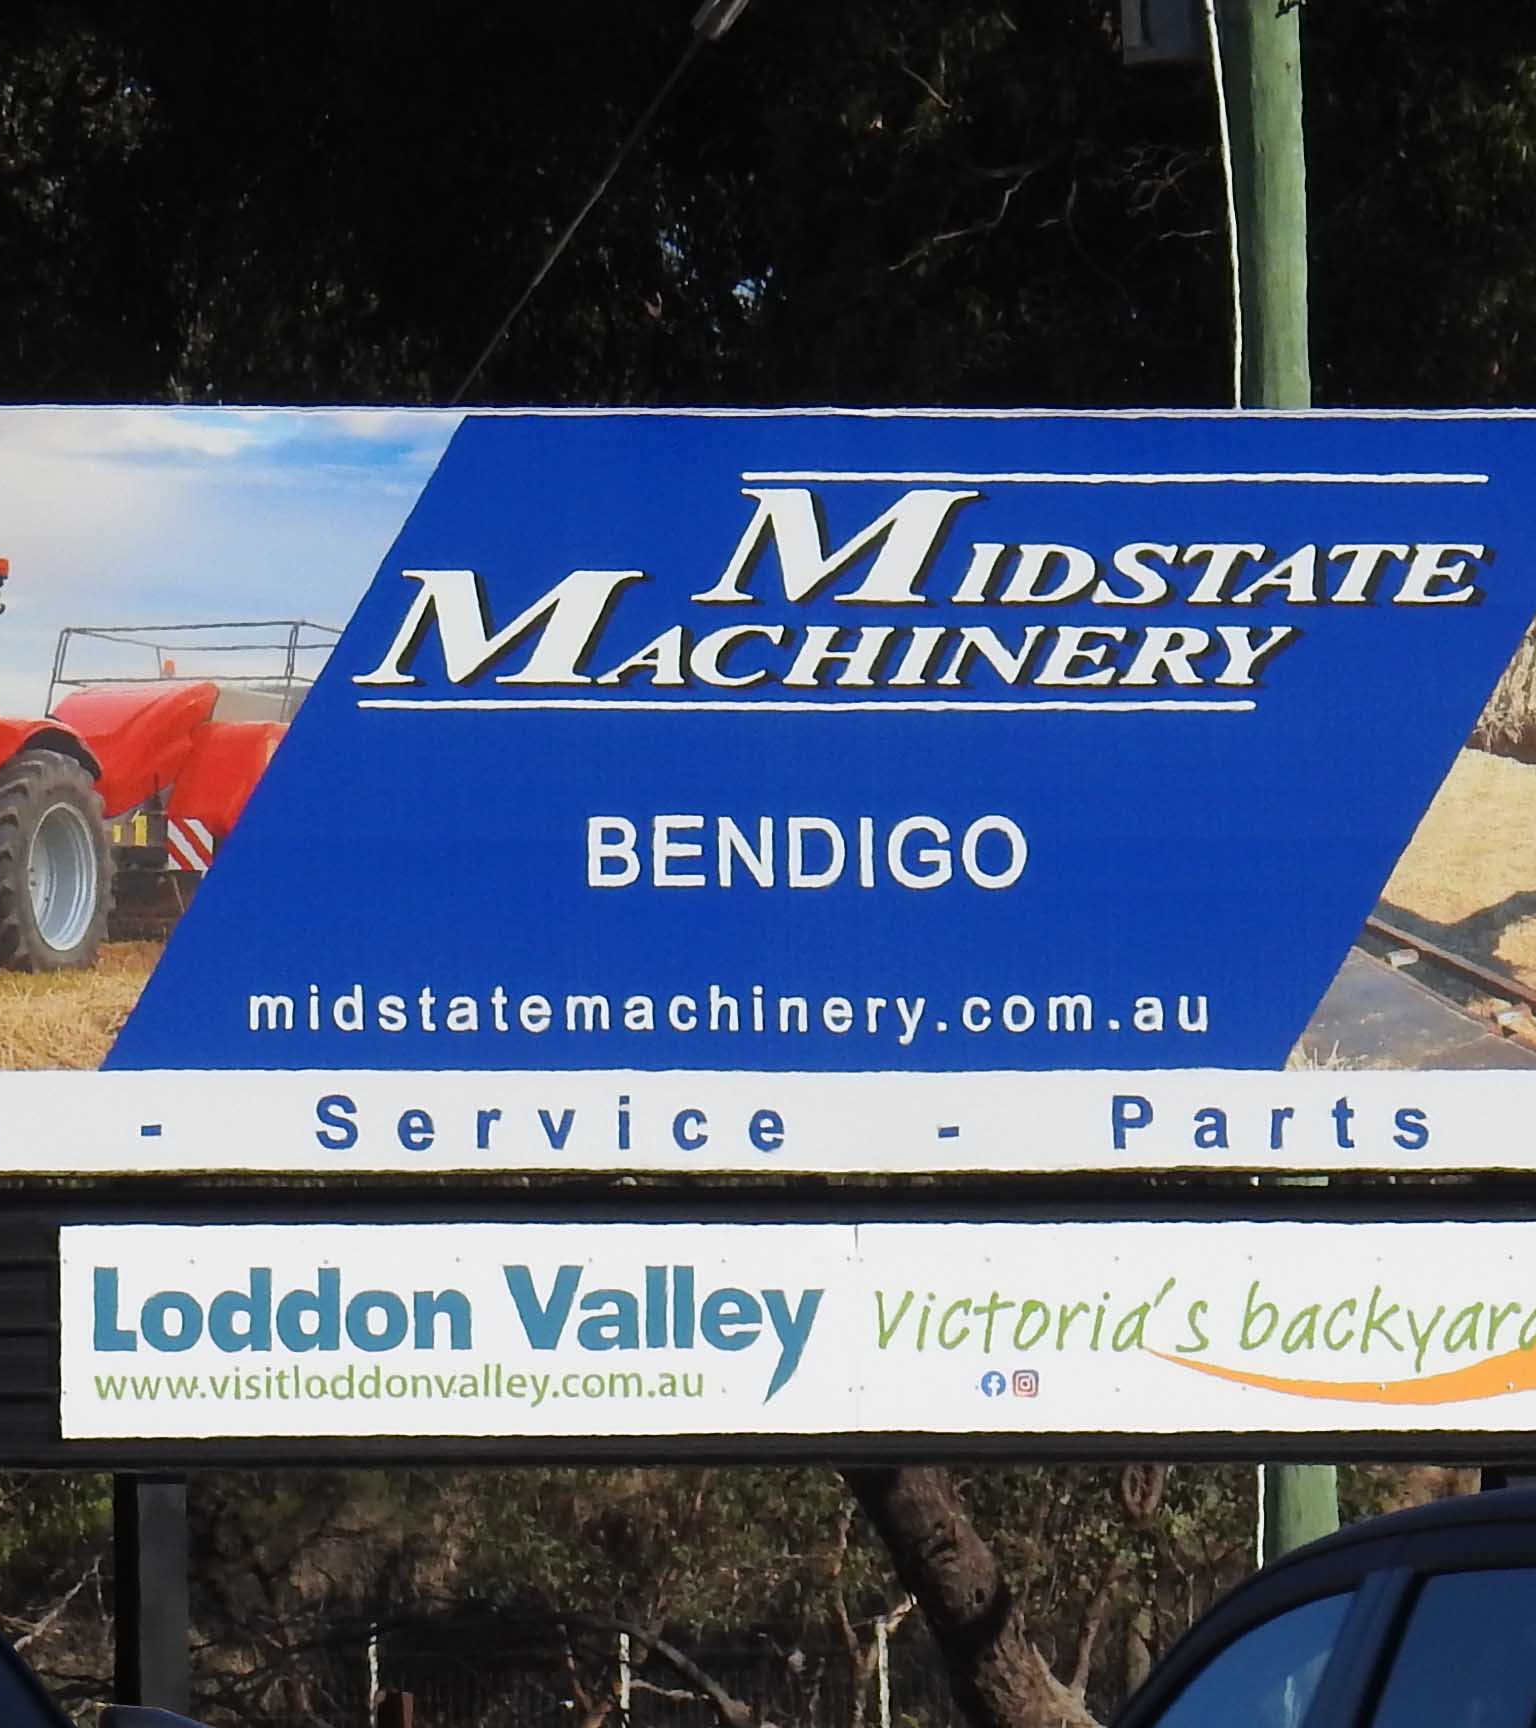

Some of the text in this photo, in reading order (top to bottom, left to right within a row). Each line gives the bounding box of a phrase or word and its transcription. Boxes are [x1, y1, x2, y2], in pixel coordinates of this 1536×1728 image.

[692, 488, 1488, 605] MIDSTATE
[352, 569, 1296, 687] MACHINERY
[587, 814, 1028, 889] BENDIGO
[249, 984, 1209, 1046] midstatemachinery.com.au
[315, 1094, 786, 1153] Service
[1110, 1095, 1430, 1150] Parts
[93, 1265, 824, 1404] Loddon Valley
[874, 1276, 1211, 1353] Victoria's
[95, 1364, 703, 1404] www.visitloddonvalley.com.au
